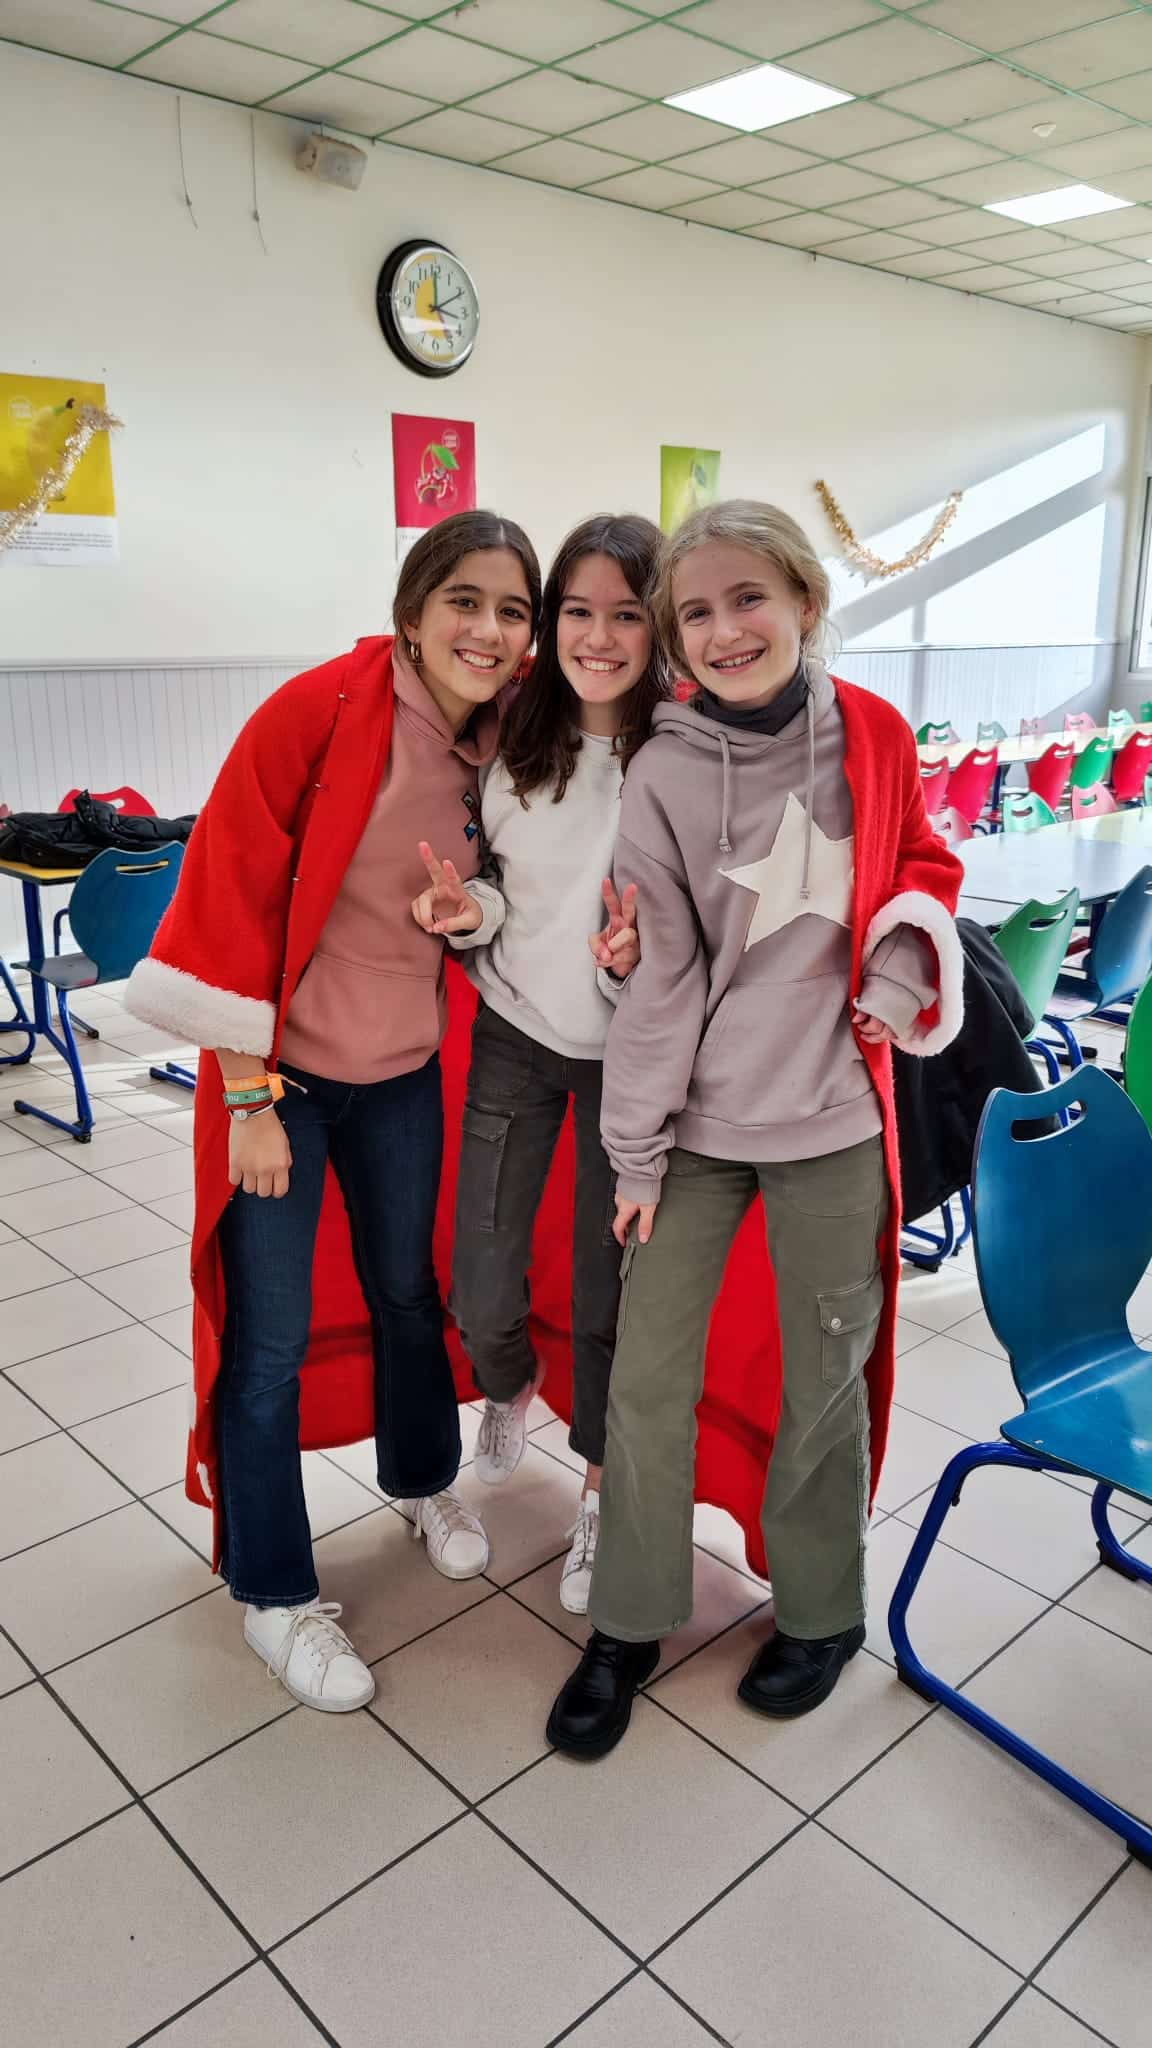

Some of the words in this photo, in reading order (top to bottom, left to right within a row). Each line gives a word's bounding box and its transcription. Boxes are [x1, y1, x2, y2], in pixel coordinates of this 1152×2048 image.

[418, 264, 428, 281] 11
[403, 297, 411, 308] 9
[460, 306, 468, 320] 3
[432, 338, 440, 351] 6
[446, 337, 454, 350] 5
